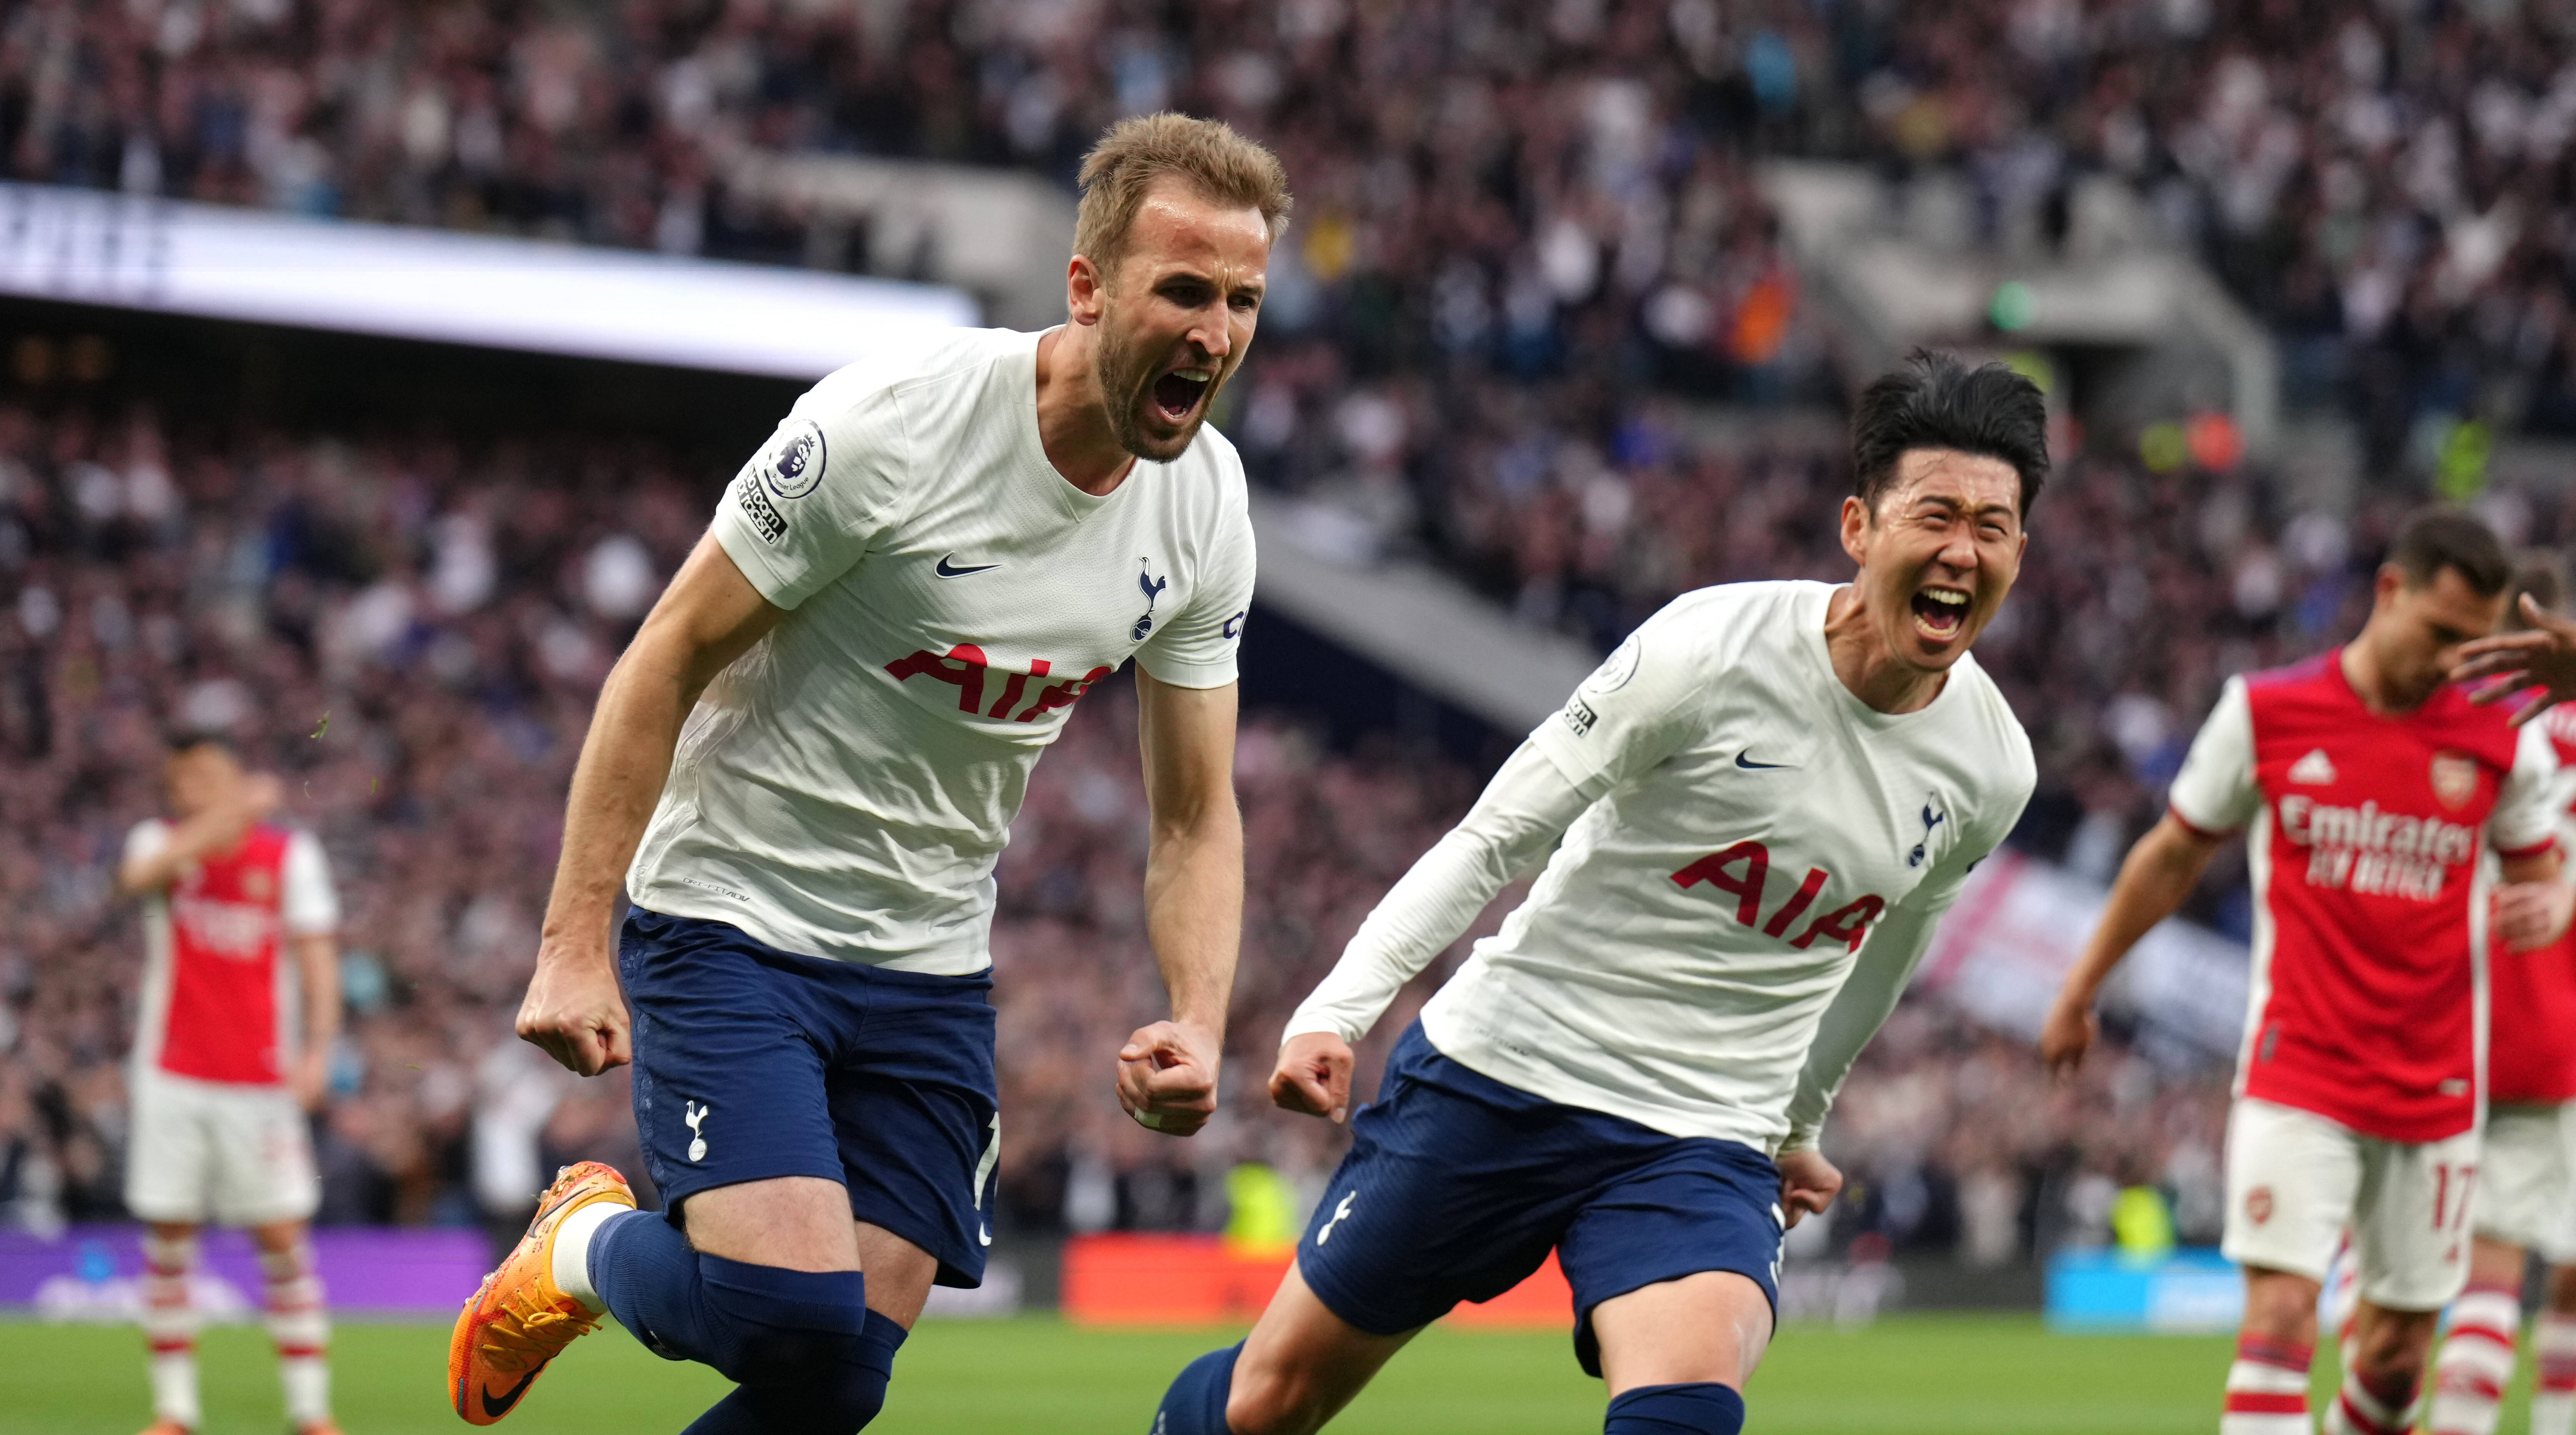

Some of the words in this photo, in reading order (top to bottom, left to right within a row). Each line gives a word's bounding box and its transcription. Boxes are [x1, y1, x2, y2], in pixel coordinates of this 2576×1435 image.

[750, 486, 780, 529] room
[790, 477, 809, 491] League
[740, 494, 777, 544] racism
[884, 643, 1111, 722] AIA
[1670, 841, 1885, 954] AIA
[2433, 1163, 2477, 1230] 17
